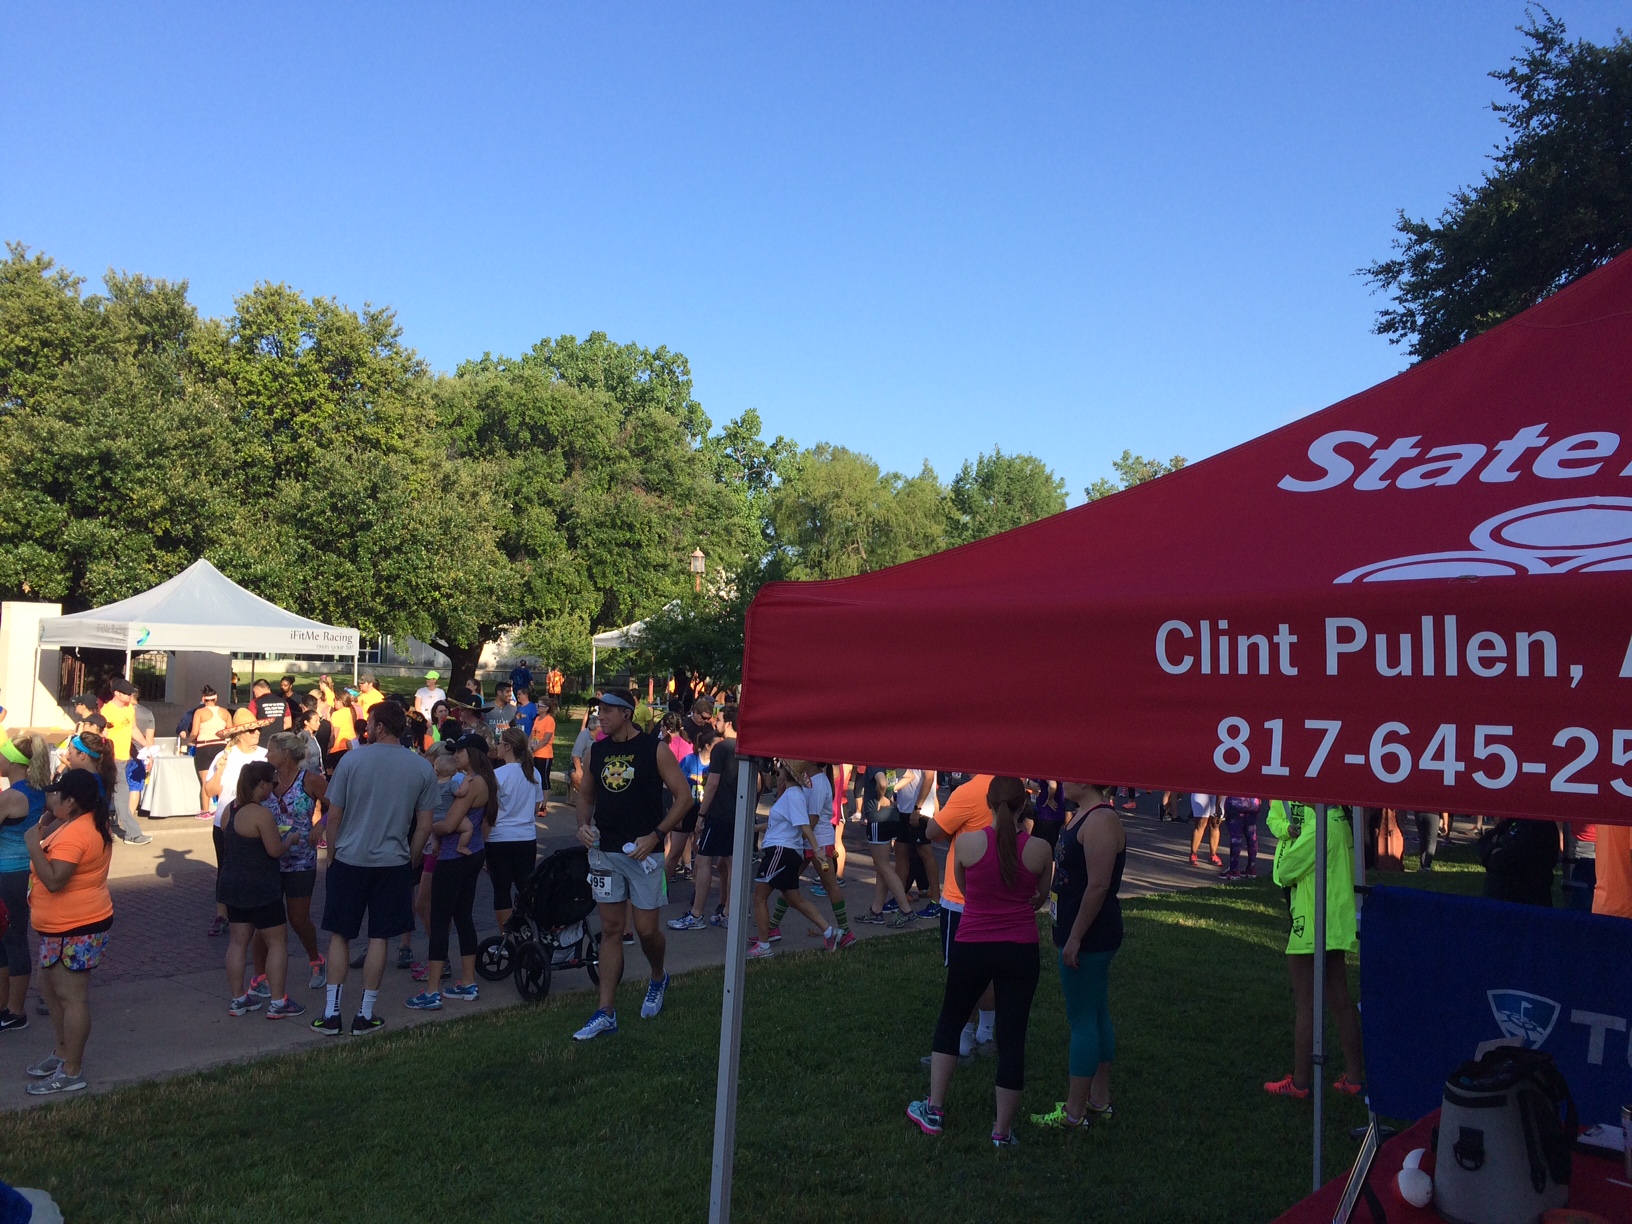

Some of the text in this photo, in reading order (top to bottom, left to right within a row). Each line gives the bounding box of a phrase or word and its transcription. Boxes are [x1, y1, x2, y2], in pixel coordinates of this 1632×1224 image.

[1276, 422, 1621, 493] State
[290, 630, 353, 645] iFitMe Racing
[1155, 619, 1298, 676] Clint
[1325, 614, 1583, 689] Pullen,
[1571, 1008, 1632, 1069] T
